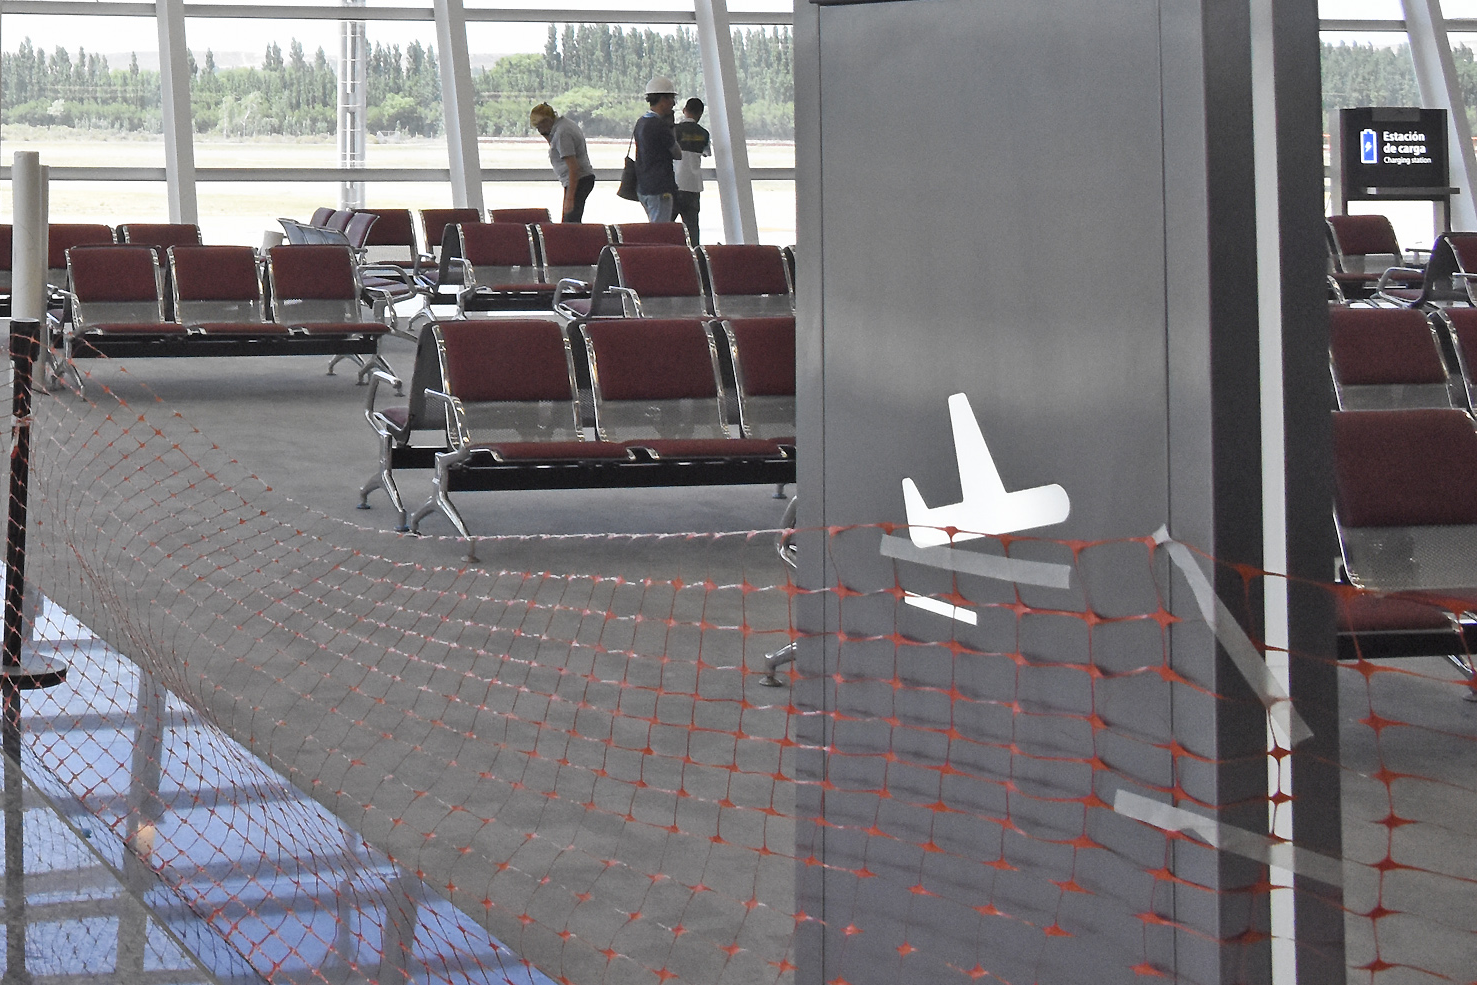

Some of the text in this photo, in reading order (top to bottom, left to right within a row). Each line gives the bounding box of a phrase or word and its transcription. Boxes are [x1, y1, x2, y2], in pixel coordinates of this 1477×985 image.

[1383, 130, 1426, 142] Estación
[1383, 143, 1427, 156] de carga
[1383, 156, 1411, 165] Charging
